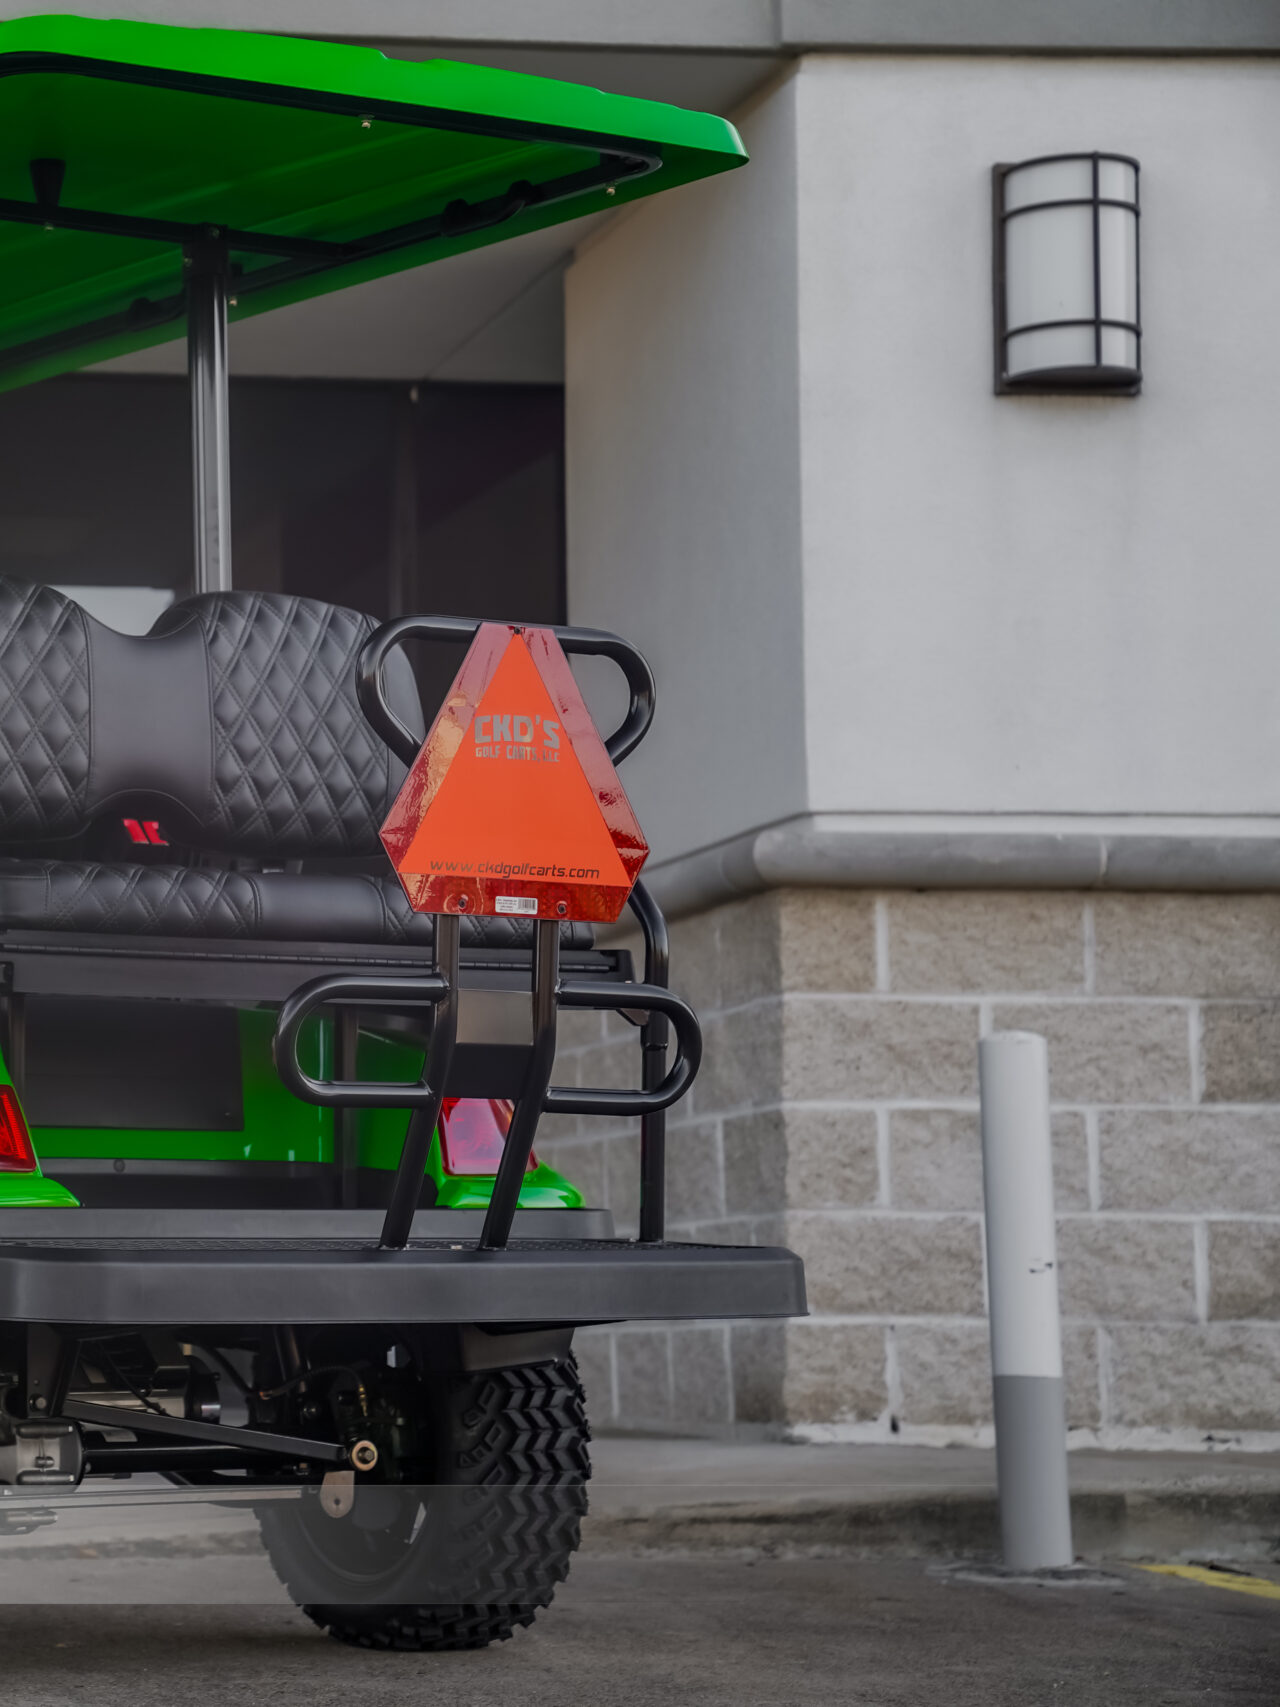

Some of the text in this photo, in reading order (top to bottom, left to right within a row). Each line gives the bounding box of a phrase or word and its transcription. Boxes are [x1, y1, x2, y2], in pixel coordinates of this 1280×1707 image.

[474, 714, 560, 749] CKD'S
[475, 745, 500, 758] GOLF
[430, 860, 600, 879] www.ckdgolfcarts.com
